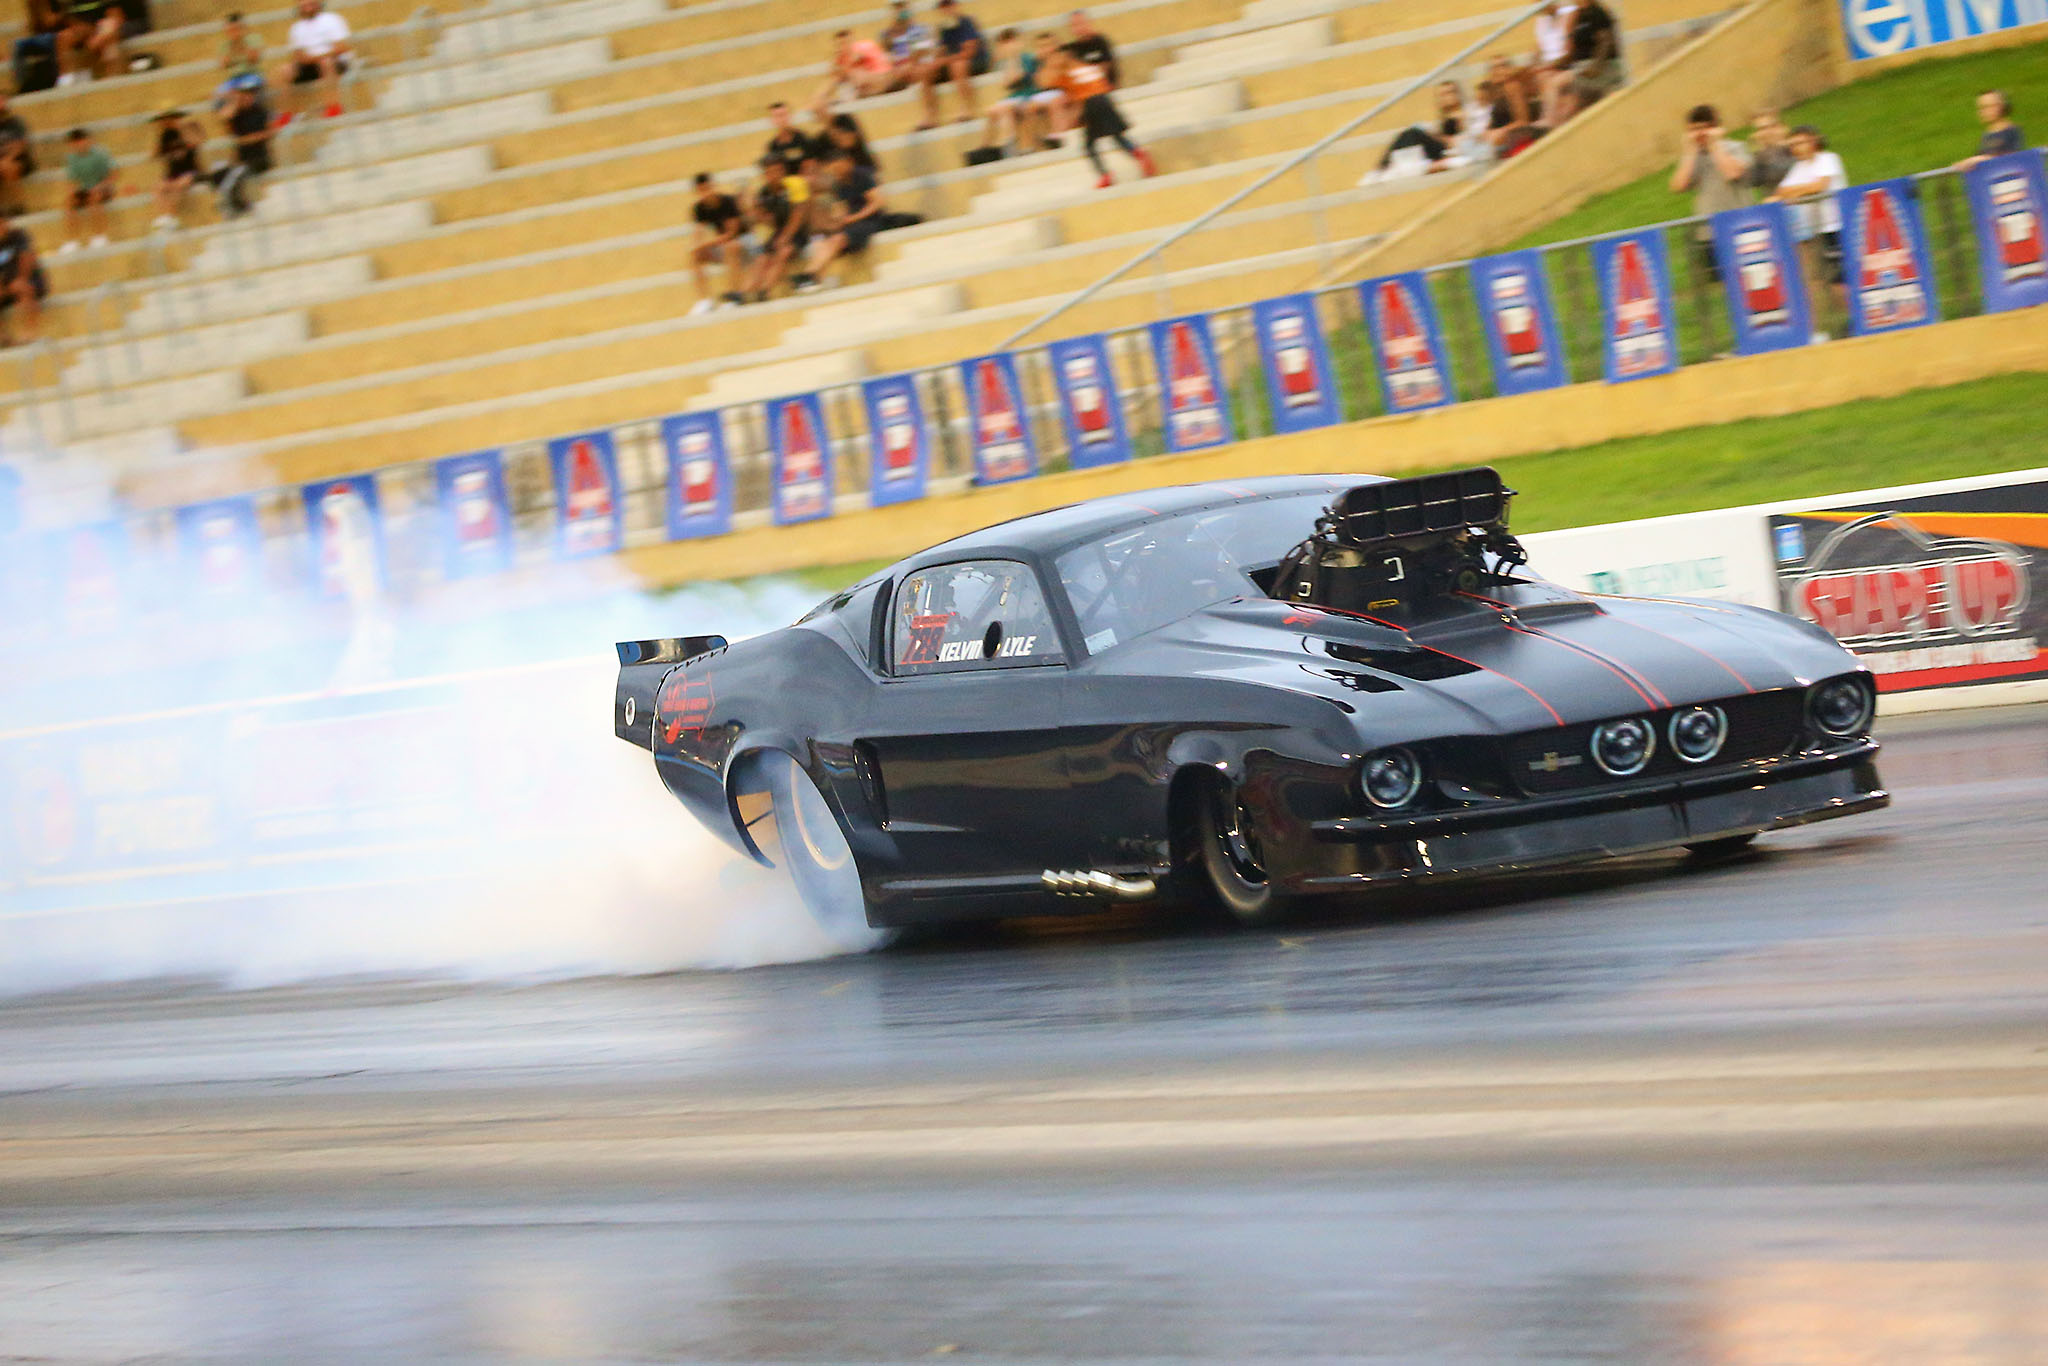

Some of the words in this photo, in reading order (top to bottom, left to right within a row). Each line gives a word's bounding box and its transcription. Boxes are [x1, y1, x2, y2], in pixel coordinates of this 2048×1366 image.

[1946, 553, 2031, 637] UP
[938, 640, 983, 662] KELVIN
[1000, 636, 1037, 657] LYLE
